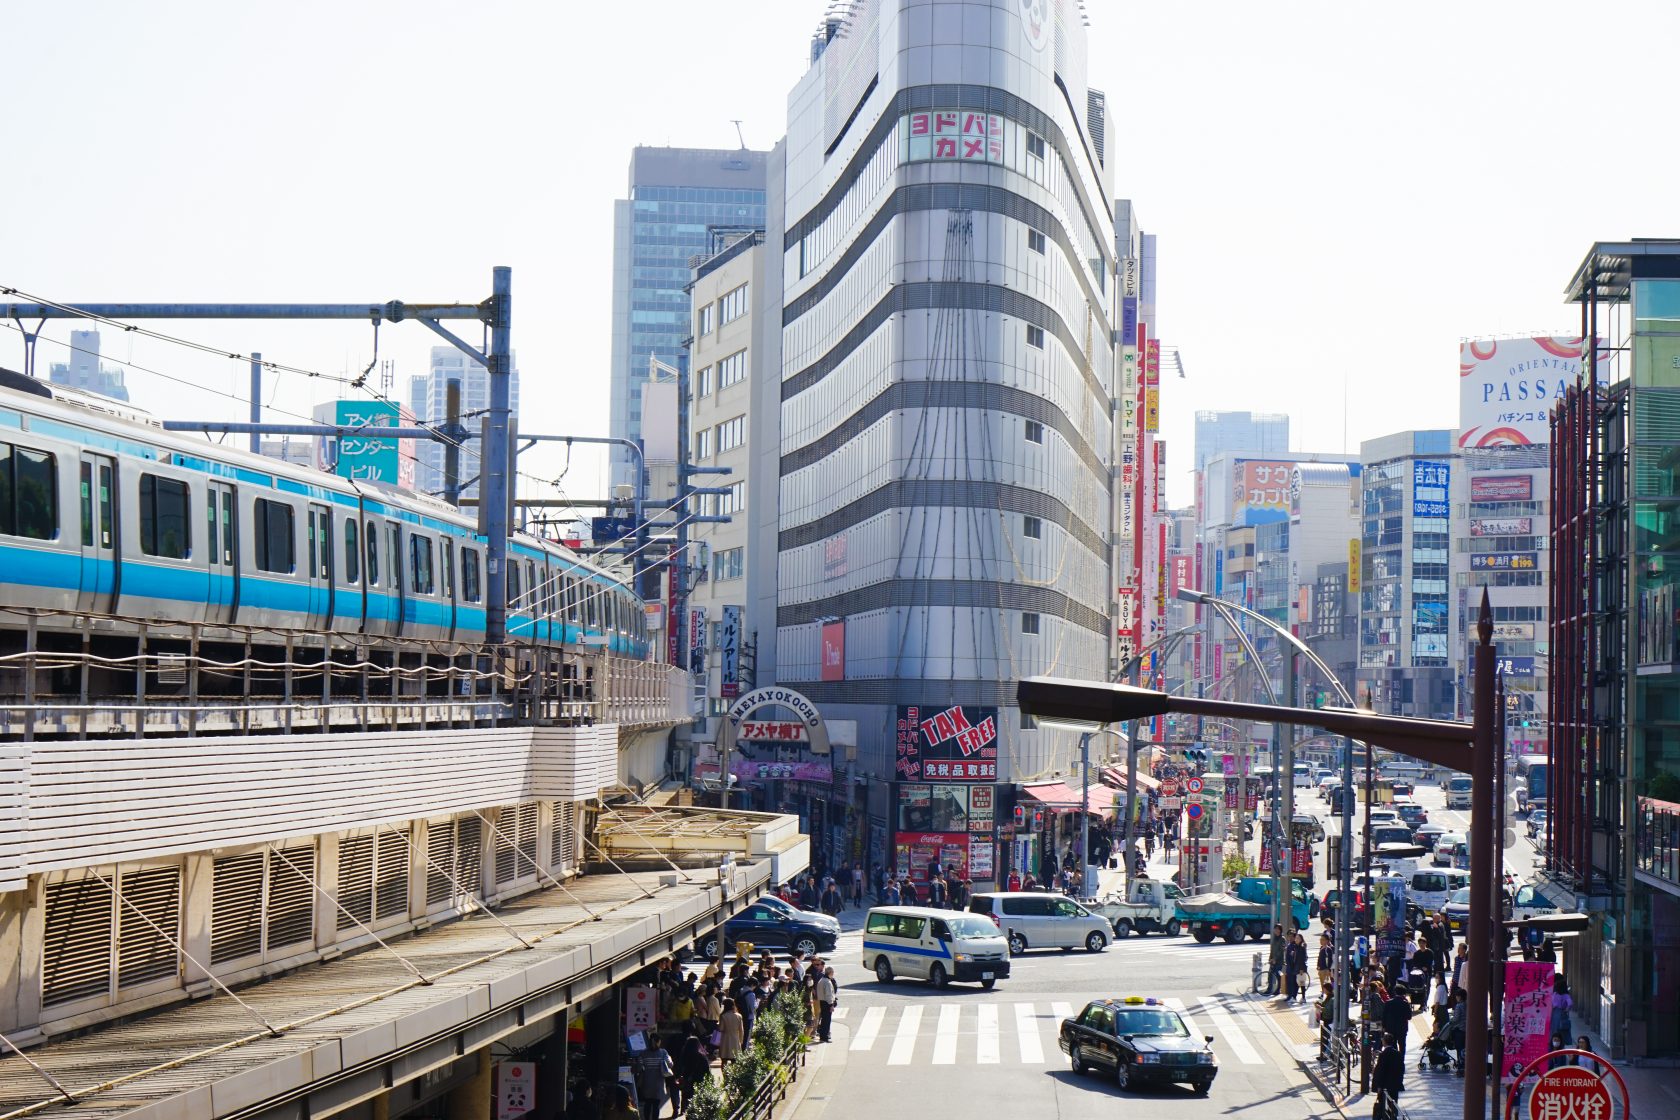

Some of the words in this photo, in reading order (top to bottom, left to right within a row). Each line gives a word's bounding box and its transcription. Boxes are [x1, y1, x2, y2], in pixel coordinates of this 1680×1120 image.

[912, 113, 1001, 135] ヨドバシ
[936, 138, 1001, 160] カメラ
[1509, 358, 1577, 376] ORIENTAL
[1497, 412, 1534, 423] パチンコ
[341, 440, 395, 455] センター
[1123, 444, 1132, 484] 上野歯科
[1256, 465, 1291, 484] サウ
[724, 624, 736, 683] ルノアール
[730, 690, 819, 727] AMEYAYOKOCHO
[742, 723, 803, 739] アメヤ横丁
[898, 718, 907, 755] カメラ
[907, 706, 919, 755] ヨドバシ
[920, 705, 972, 747] TAX
[956, 715, 996, 757] FREE
[1544, 1077, 1561, 1087] FIRE
[1563, 1078, 1598, 1087] HYDRANT
[1537, 1092, 1606, 1120] 消火栓
